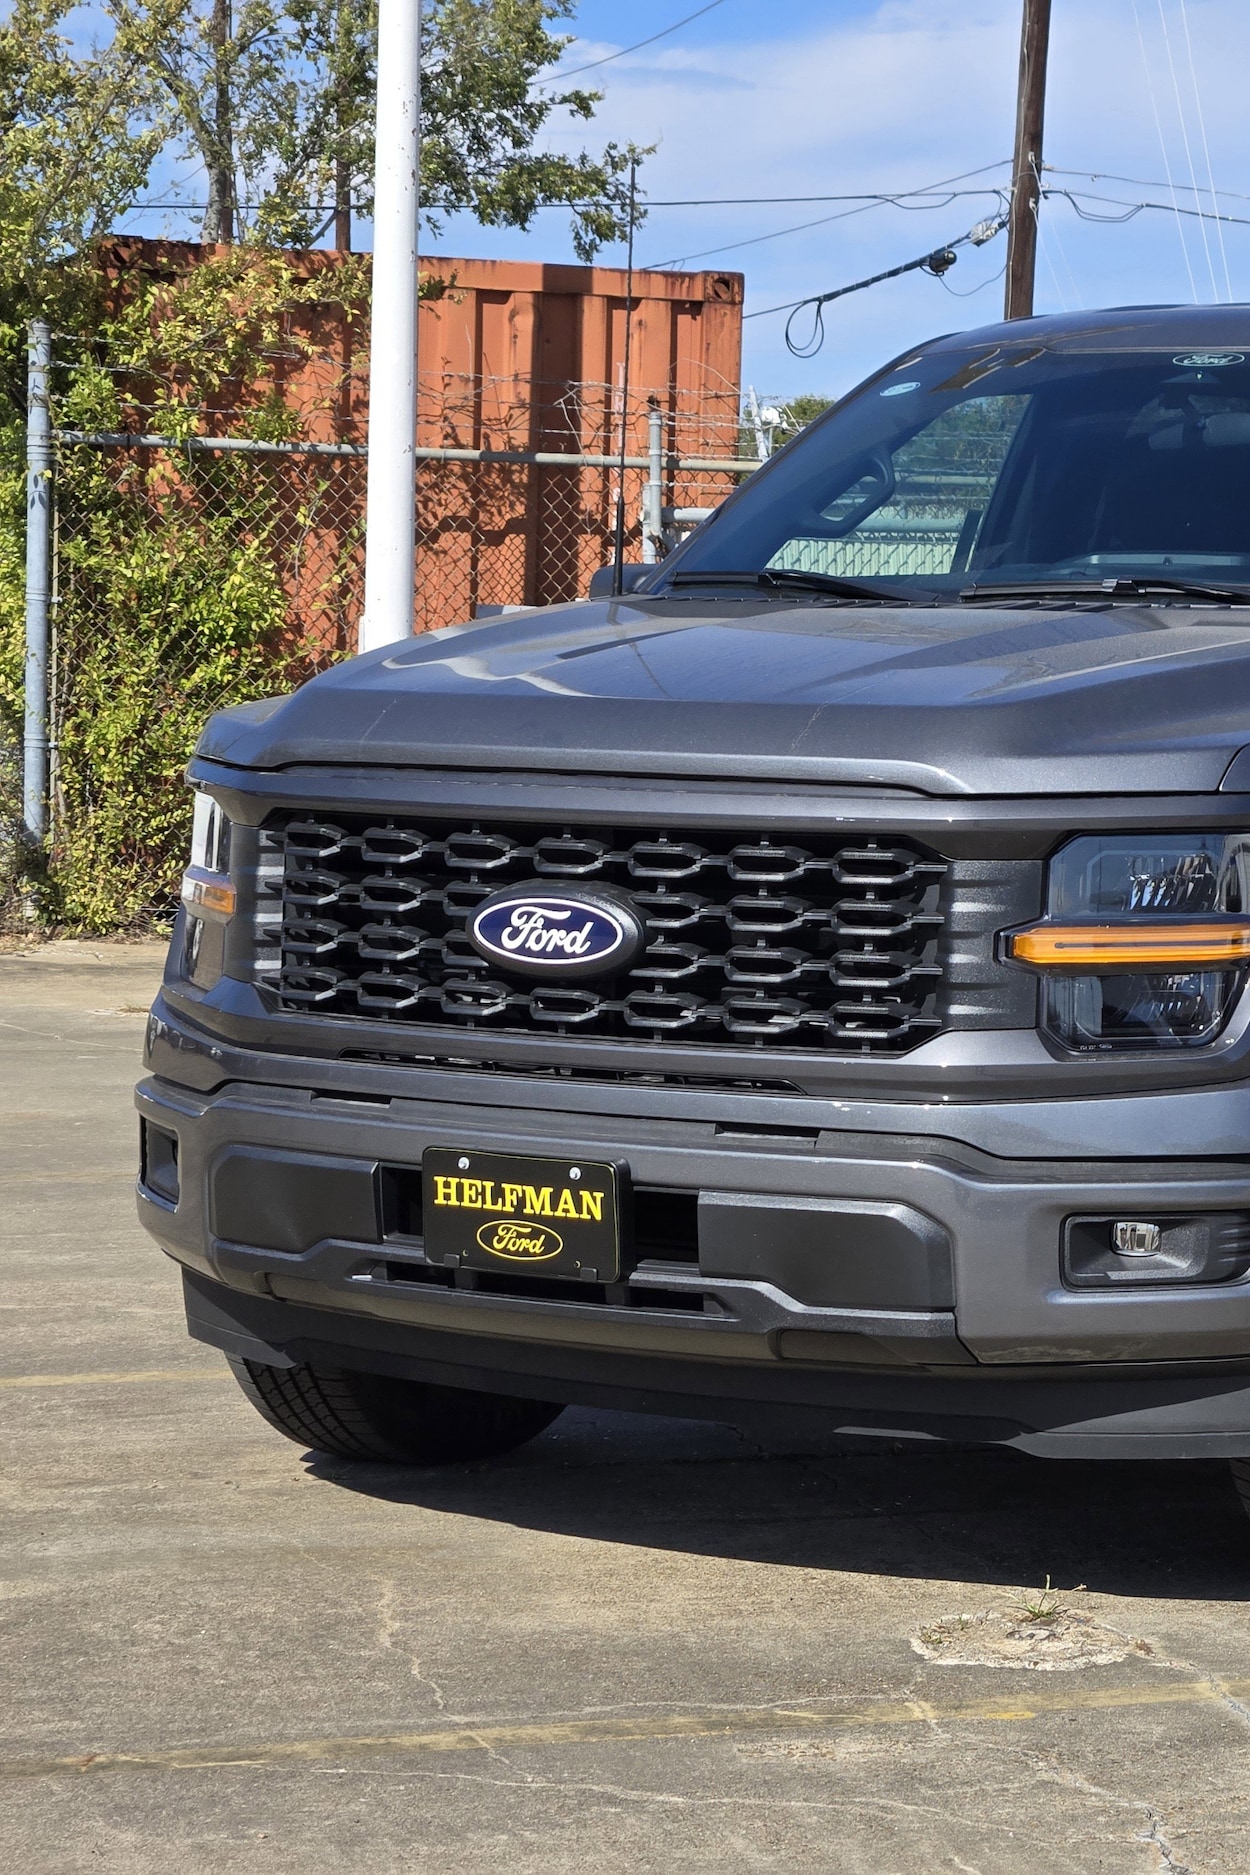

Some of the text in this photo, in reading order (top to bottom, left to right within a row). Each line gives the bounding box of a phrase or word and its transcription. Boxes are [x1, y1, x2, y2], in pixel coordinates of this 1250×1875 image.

[501, 905, 592, 954] Ford
[433, 1176, 605, 1220] HELFMAN
[493, 1223, 546, 1254] Ford
